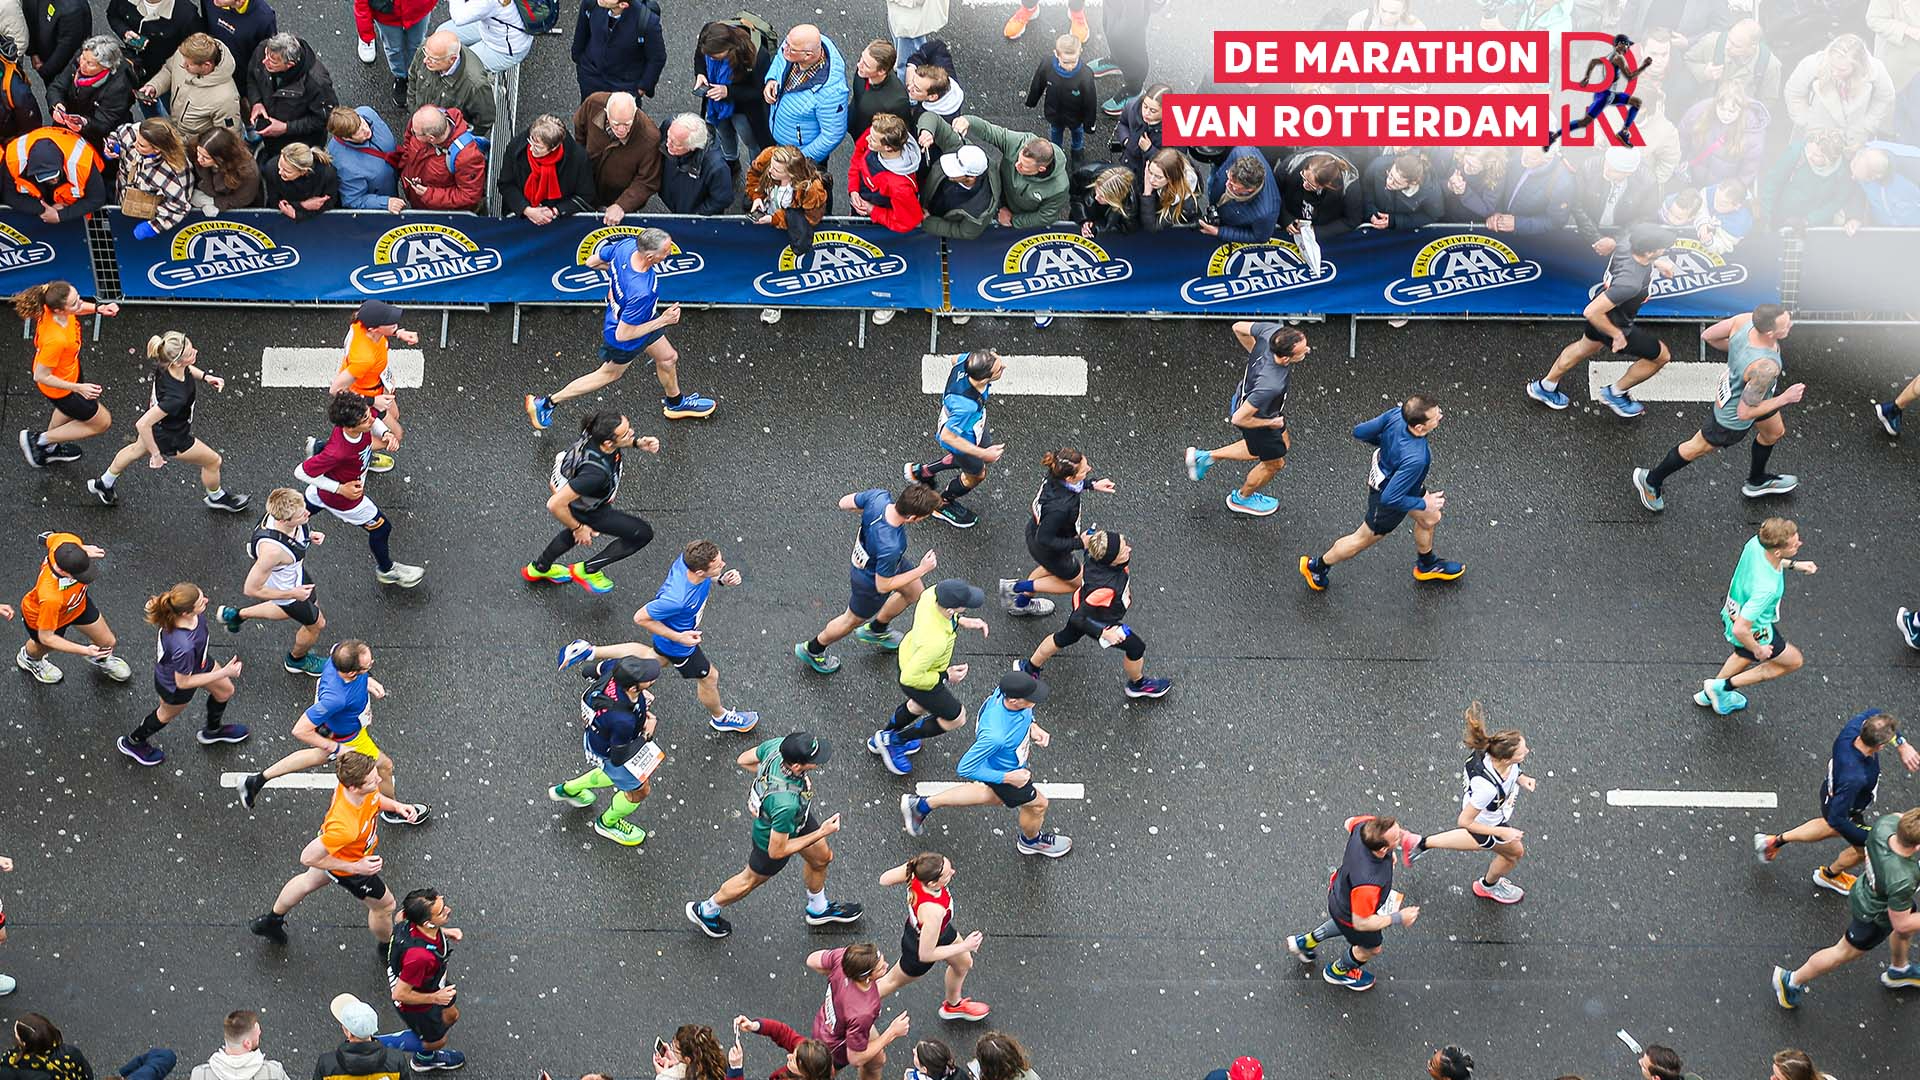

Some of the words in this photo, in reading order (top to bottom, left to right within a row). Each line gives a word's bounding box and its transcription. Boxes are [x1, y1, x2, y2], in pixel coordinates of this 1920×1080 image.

[0, 225, 22, 239] RINK
[176, 236, 187, 250] ALL
[188, 222, 232, 236] ACTIVITY
[237, 225, 266, 242] DRINK
[378, 240, 391, 254] ALL
[391, 226, 435, 240] ACTIVITY
[441, 228, 469, 246] DRINK
[581, 240, 594, 254] ALL
[593, 227, 639, 240] ACTIVITY
[815, 232, 842, 242] IVITY
[203, 235, 260, 262] AA
[406, 238, 462, 266] AA
[810, 248, 867, 272] AA
[1008, 249, 1022, 264] ALL
[1021, 234, 1068, 248] ACTIVITY
[1074, 237, 1102, 253] DRINK
[1034, 248, 1092, 276] AA
[1417, 253, 1431, 268] ALL
[1430, 236, 1478, 252] ACTIVITY
[1484, 239, 1512, 256] DRINK
[194, 254, 274, 278] DRINK
[397, 256, 477, 283] DRINK
[800, 263, 880, 288] DRINK
[1238, 250, 1296, 278] AA
[1442, 250, 1502, 278] AA
[1024, 266, 1106, 292] DRINK
[1228, 268, 1310, 295] DRINK
[1432, 268, 1514, 294] DRINK
[1648, 272, 1721, 296] DRINK
